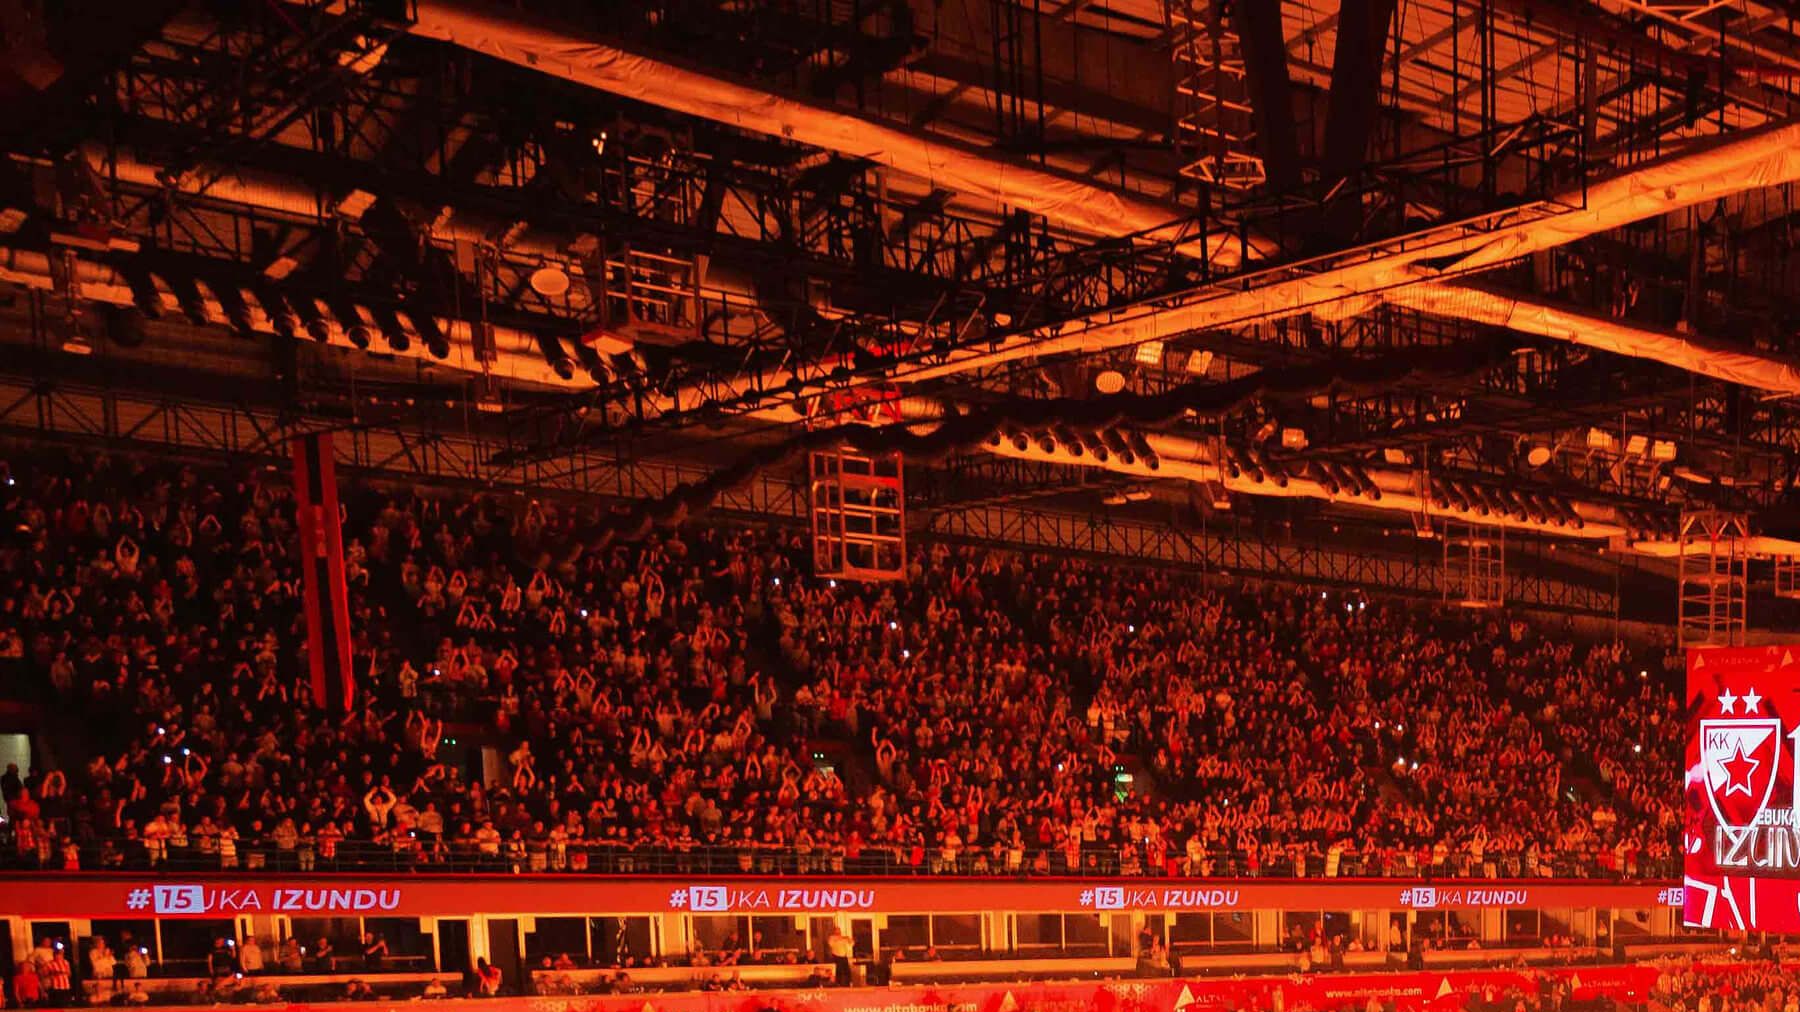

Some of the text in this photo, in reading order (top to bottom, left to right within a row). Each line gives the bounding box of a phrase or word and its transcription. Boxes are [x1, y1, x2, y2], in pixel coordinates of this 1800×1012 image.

[1709, 732, 1730, 750] KK
[272, 888, 401, 911] IZUNDU
[777, 889, 875, 909] IZUNDU
[1162, 889, 1239, 907] IZUNDU
[1466, 889, 1528, 906] IZUNDU
